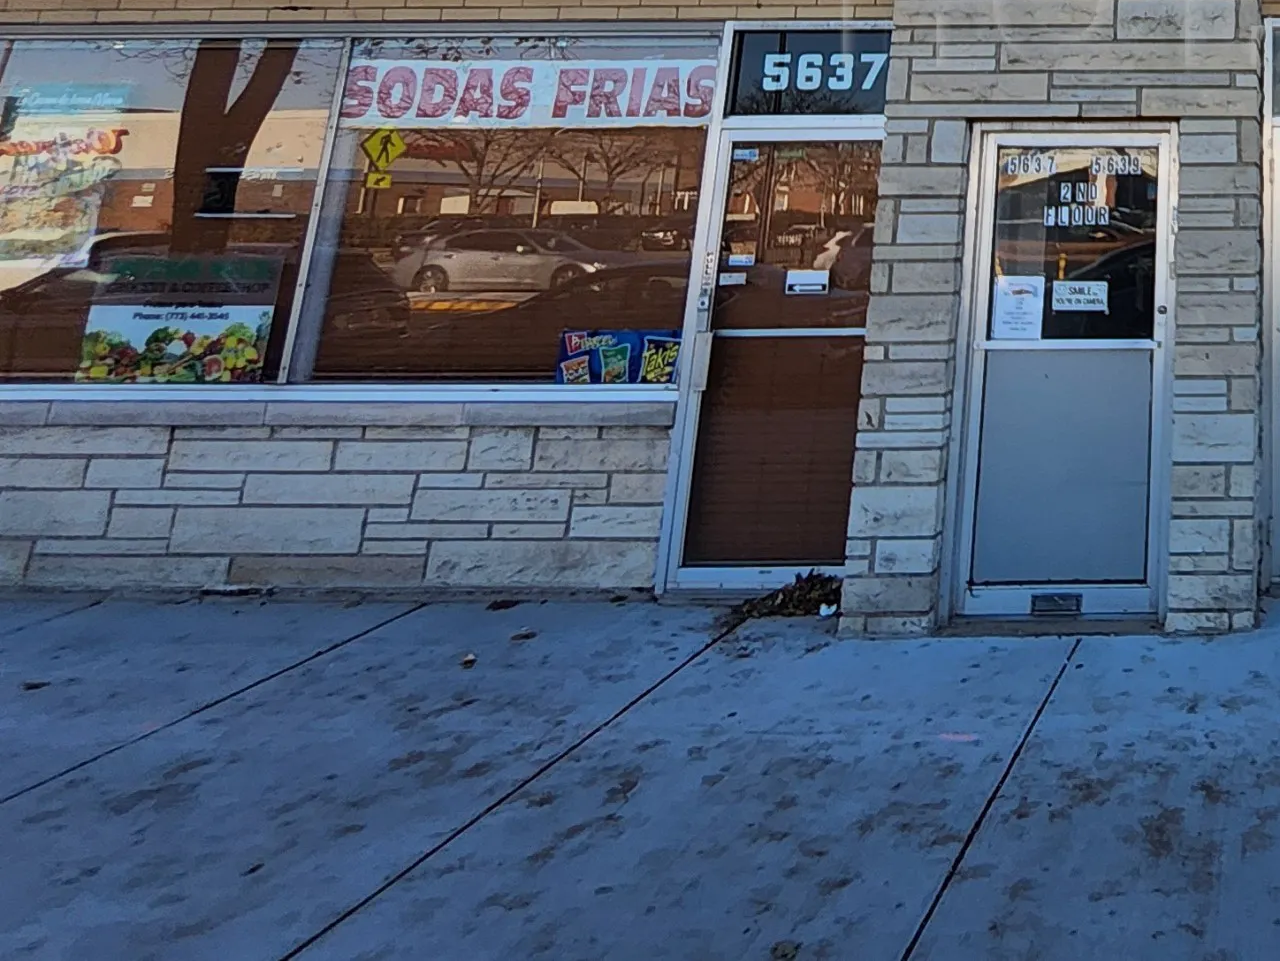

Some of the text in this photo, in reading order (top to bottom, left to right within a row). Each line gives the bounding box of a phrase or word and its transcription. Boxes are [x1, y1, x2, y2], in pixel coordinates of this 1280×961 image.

[762, 52, 890, 92] 5637
[340, 64, 717, 120] SODAS FRIAS
[1009, 156, 1056, 174] 5637
[1093, 156, 1141, 174] 5639
[1061, 184, 1098, 202] 2ND
[1046, 207, 1109, 225] FLOOR
[643, 343, 680, 375] Takis
